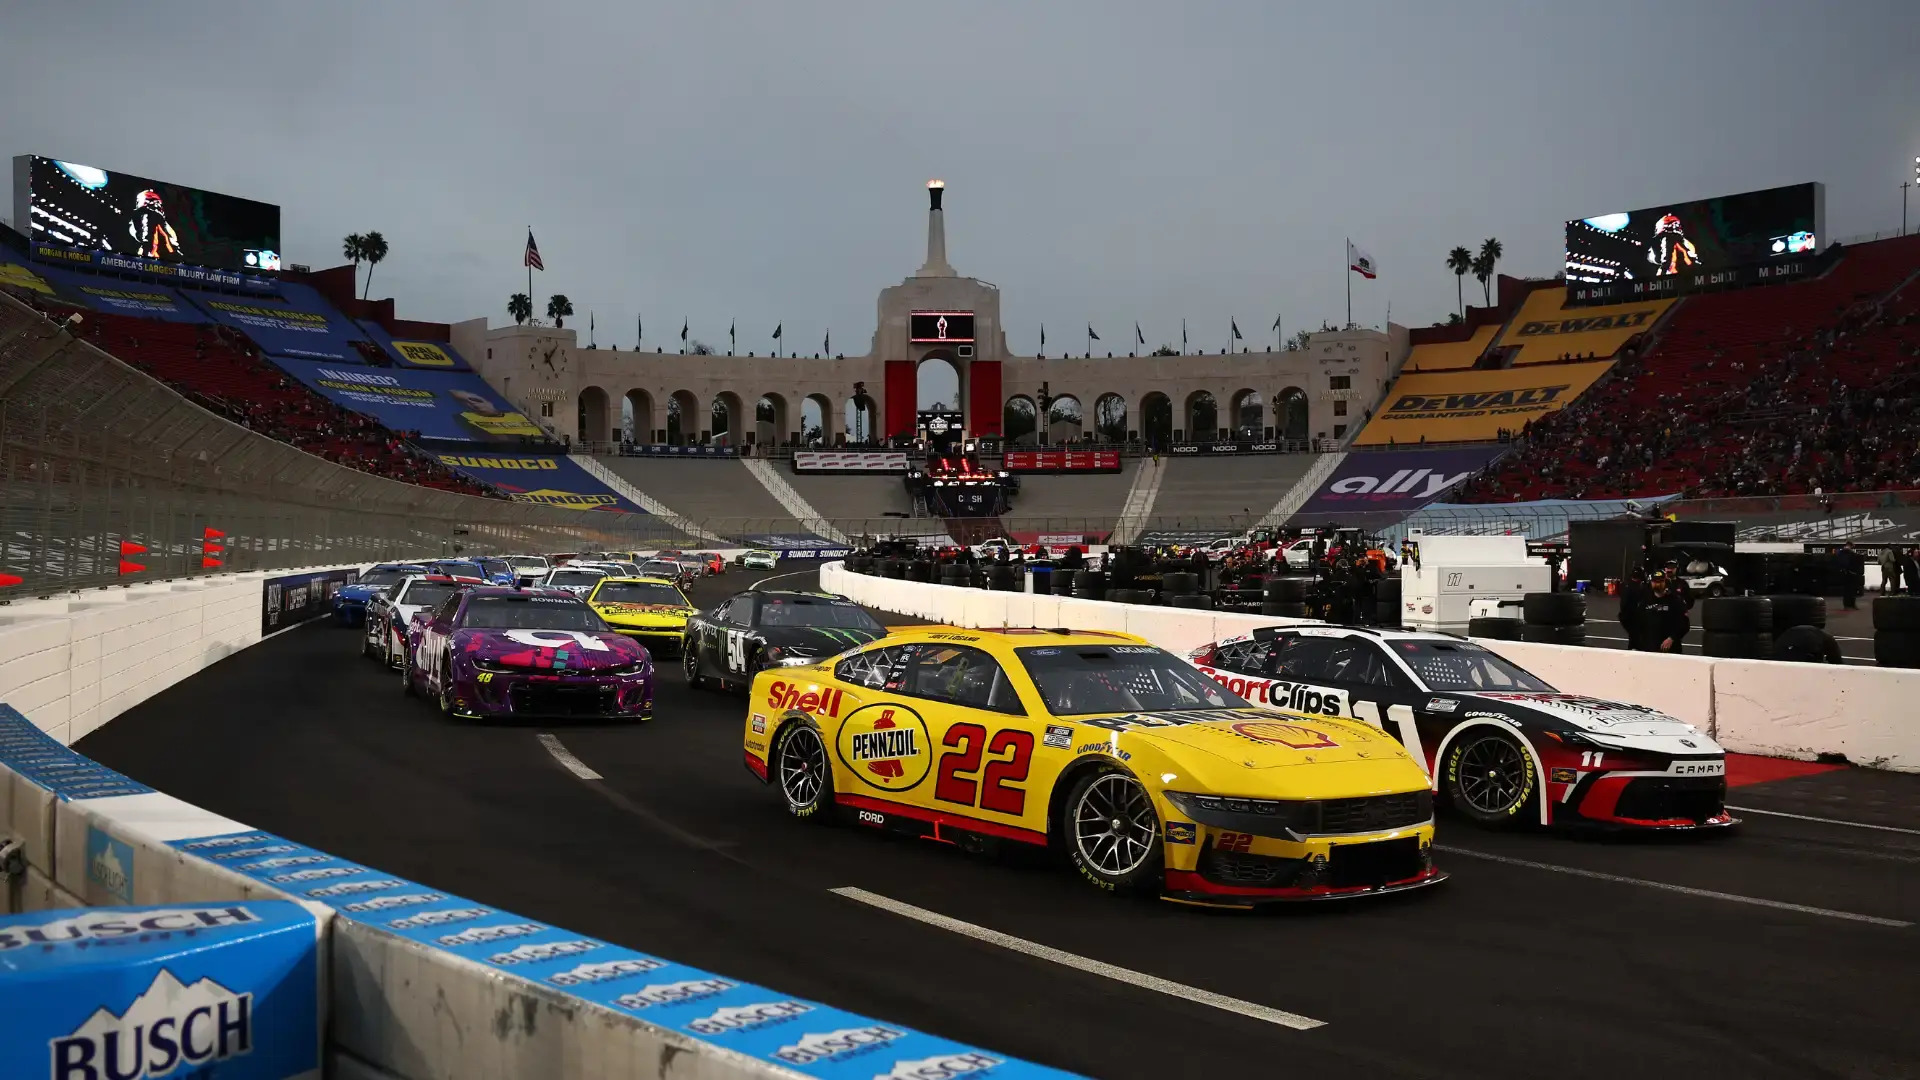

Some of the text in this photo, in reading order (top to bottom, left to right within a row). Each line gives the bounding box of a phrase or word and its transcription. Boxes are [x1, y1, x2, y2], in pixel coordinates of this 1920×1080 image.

[39, 247, 62, 259] MORGAN
[68, 252, 91, 263] MORGAN
[101, 256, 143, 271] AMERICA'S
[144, 263, 177, 276] LARGEST
[178, 268, 205, 280] INJURY
[206, 272, 222, 283] LAW
[222, 275, 240, 286] FIRM
[1517, 311, 1656, 336] DEWALT
[317, 368, 401, 387] INJURED?
[319, 380, 370, 392] MORGAN
[382, 387, 434, 398] MORGAN
[1389, 385, 1570, 411] DEWALT
[1381, 409, 1487, 420] GUARANTEED
[438, 455, 558, 470] SUNOCO
[1330, 468, 1475, 499] ally
[788, 550, 816, 558] SUNOCO
[1447, 572, 1463, 587] 11
[531, 597, 578, 605] BOWMAN
[727, 629, 747, 675] 54
[476, 672, 494, 684] 48
[767, 681, 843, 718] Shell
[1464, 710, 1523, 728] GOODYEAR
[853, 729, 917, 760] PENNZOIL
[934, 721, 1035, 817] 22
[1447, 746, 1463, 783] EAGLE
[1580, 750, 1604, 767] 11
[1675, 763, 1723, 775] CAMRY
[1508, 745, 1537, 816] GOODYEAR
[859, 811, 885, 825] FORD
[1167, 829, 1195, 838] SUNOCO
[1216, 832, 1254, 853] 22
[268, 865, 370, 883] BUSCH
[1080, 867, 1115, 891] EAGLE
[304, 879, 407, 898] BUSCH
[343, 893, 443, 913] BUSCH
[0, 908, 254, 949] BUSCH
[387, 907, 492, 930] BUSCH
[435, 922, 544, 947] BUSCH
[487, 939, 601, 966] BUSCH
[546, 958, 663, 987] BUSCH
[614, 979, 733, 1010] BUSCH
[687, 1001, 812, 1034] BUSCH
[54, 996, 250, 1080] BUSCH
[776, 1025, 902, 1064] BUSCH
